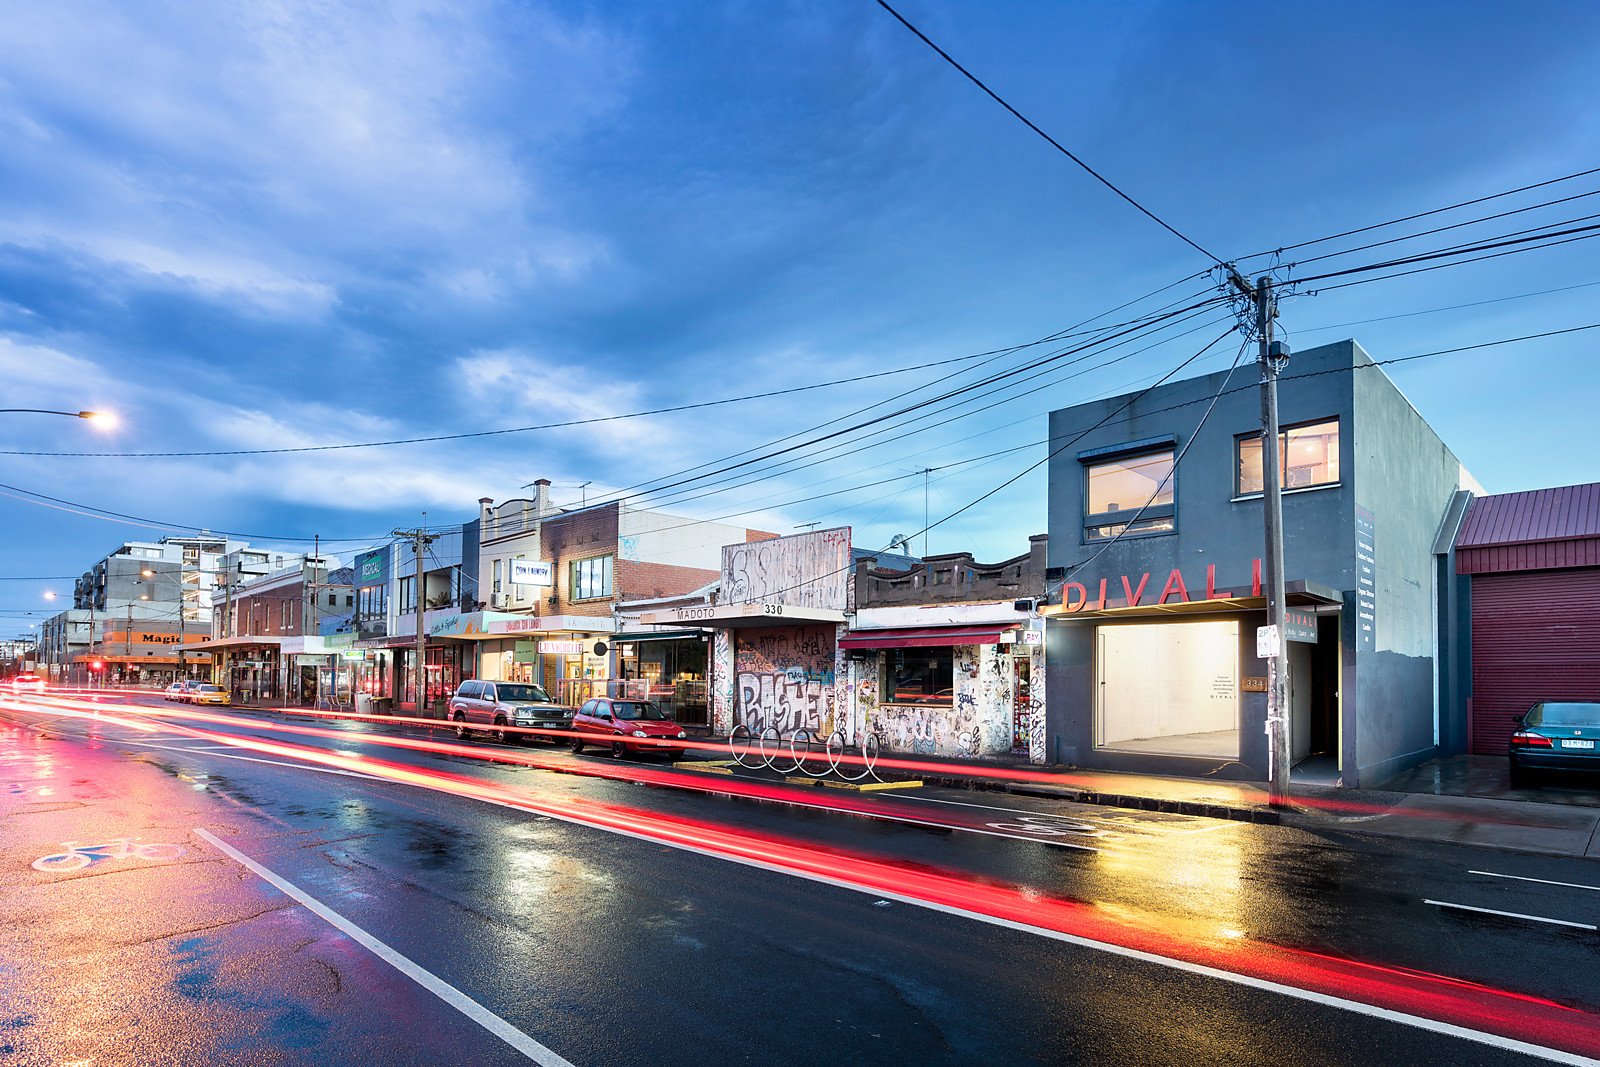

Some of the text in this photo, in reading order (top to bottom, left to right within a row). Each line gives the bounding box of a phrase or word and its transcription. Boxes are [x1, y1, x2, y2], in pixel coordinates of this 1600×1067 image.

[1062, 558, 1262, 613] DIVALI
[677, 608, 715, 620] MADOTO
[764, 604, 783, 615] 330
[1285, 612, 1317, 627] DIVALI
[1258, 629, 1269, 638] 2P
[1246, 679, 1263, 687] 334
